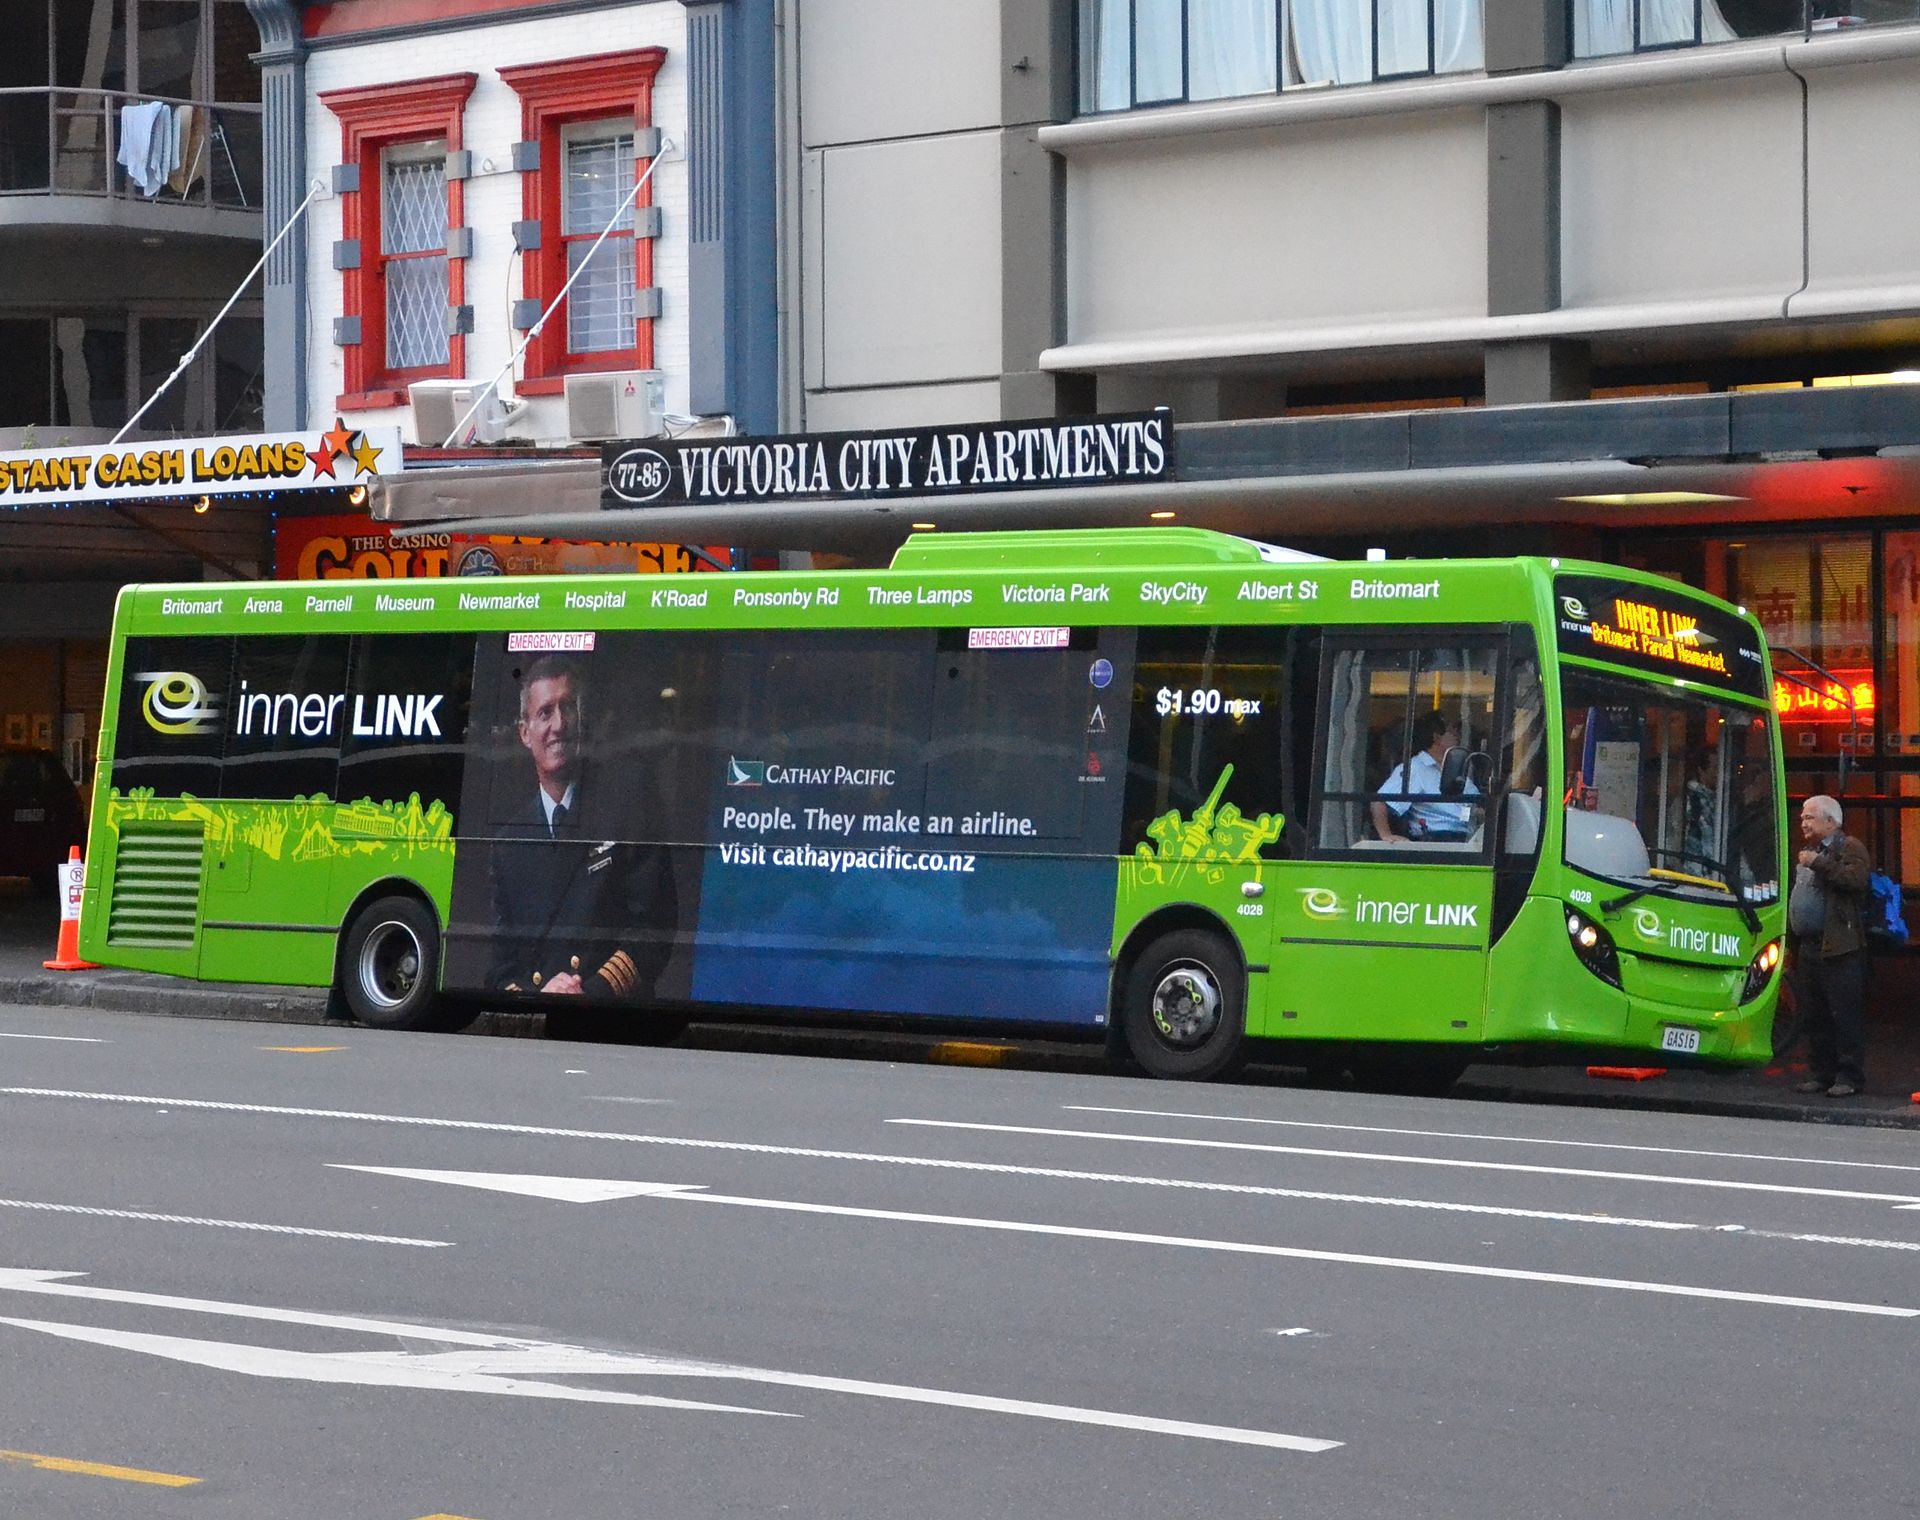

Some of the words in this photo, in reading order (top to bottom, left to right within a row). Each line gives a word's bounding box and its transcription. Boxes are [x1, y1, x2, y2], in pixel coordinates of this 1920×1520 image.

[96, 449, 190, 487] CASH
[192, 441, 306, 480] LOANS
[678, 441, 831, 499] VICTORIA
[839, 435, 918, 491] CITY
[924, 419, 1165, 487] APARTMENTS
[618, 461, 663, 490] 77-85
[352, 536, 384, 550] THE
[388, 533, 451, 548] CASINO
[651, 589, 708, 607] K'Road
[733, 588, 812, 610] Ponsonby
[816, 587, 840, 605] Rd
[867, 586, 913, 605] Three
[917, 586, 973, 607] Lamps
[1001, 584, 1066, 603] Victoria
[1070, 583, 1110, 602] Park
[1139, 581, 1208, 605] SkyCity
[1236, 580, 1293, 600] Albert
[1297, 579, 1319, 599] St
[1350, 578, 1441, 599] Britomart
[162, 598, 223, 614] Britomart
[243, 597, 283, 613] Arena
[305, 595, 352, 612] Parnell
[375, 595, 434, 611] Museum
[458, 592, 540, 610] Newmarket
[564, 590, 626, 611] Hospital
[1615, 599, 1661, 637] INNER
[1662, 609, 1701, 647] LINK
[509, 634, 562, 650] EMERGENCY
[564, 633, 583, 649] EXIT
[969, 630, 1032, 647] EMERGENCY
[1033, 629, 1055, 646] EXIT
[236, 680, 345, 736] inner
[352, 694, 444, 736] LINK
[1155, 686, 1220, 717] $1.90
[1223, 699, 1261, 714] max
[766, 764, 832, 785] CATHAY
[834, 765, 896, 786] PACIFIC
[723, 806, 797, 834] People.
[803, 808, 856, 836] They
[862, 809, 920, 834] make
[927, 815, 953, 834] an
[960, 811, 1038, 836] airline.
[719, 843, 766, 865] Visit
[772, 843, 975, 873] cathaypacific.co.nz
[1569, 888, 1592, 904] 4028
[1236, 904, 1263, 916] 4028
[1356, 893, 1420, 924] inner
[1424, 904, 1477, 927] LINK
[1669, 919, 1709, 953] inner
[1712, 932, 1740, 958] LINK
[1666, 1031, 1696, 1050] GAS16
